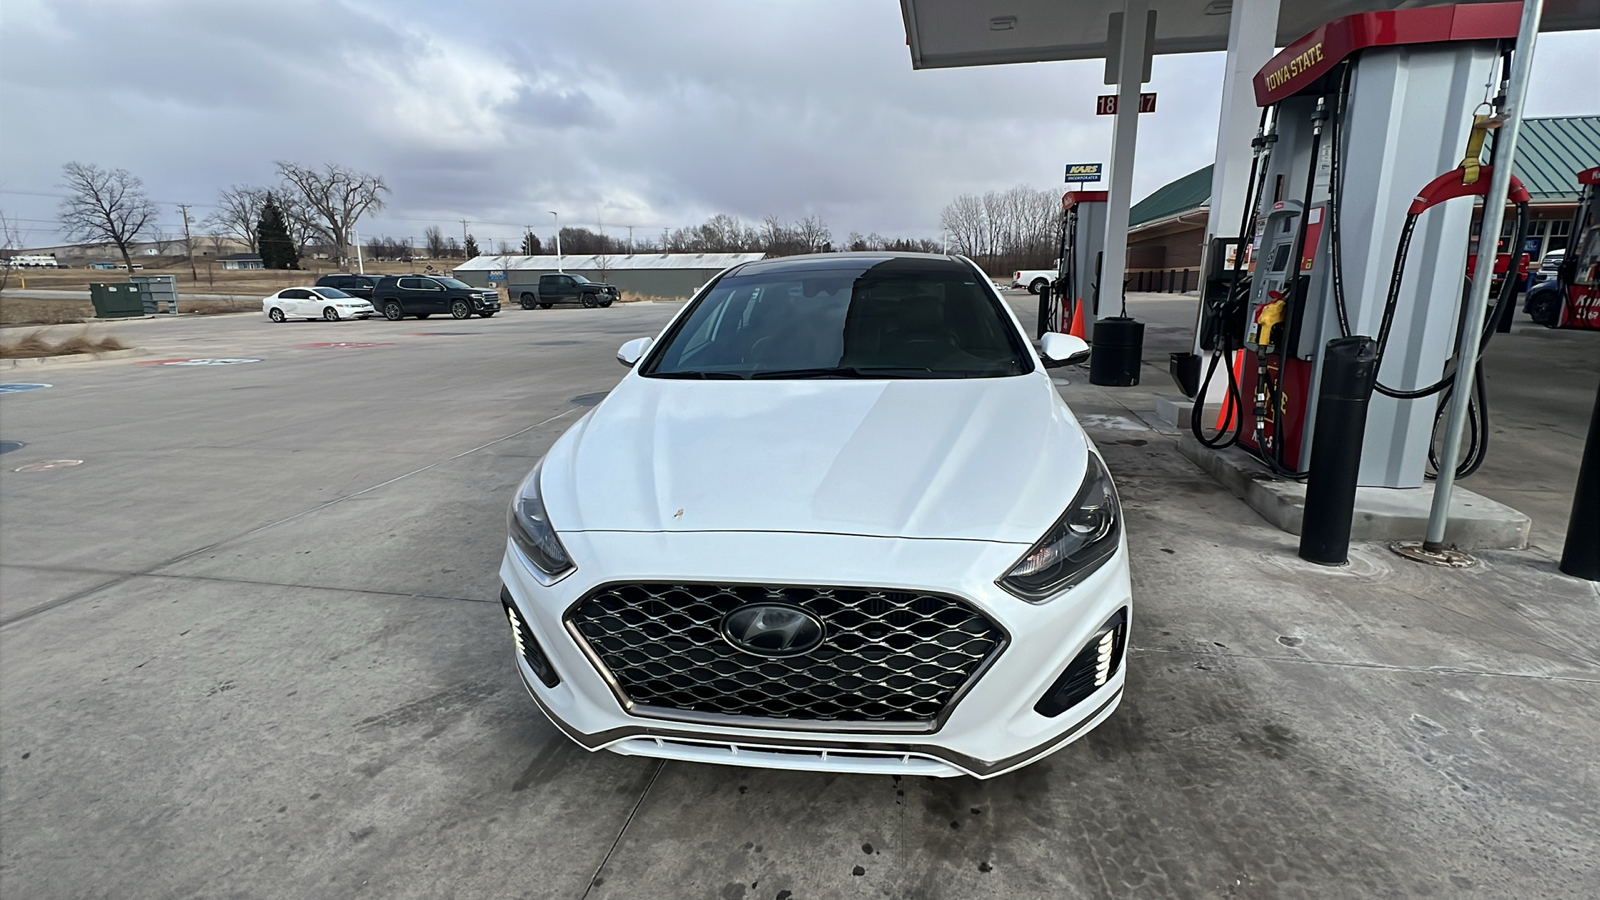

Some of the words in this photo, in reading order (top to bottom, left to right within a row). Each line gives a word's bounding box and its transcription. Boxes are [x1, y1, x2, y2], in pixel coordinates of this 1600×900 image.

[1266, 65, 1291, 92] IOWA
[1290, 43, 1324, 78] STATE
[1099, 97, 1115, 114] 18
[1139, 95, 1155, 111] 17
[1069, 165, 1098, 174] KARS
